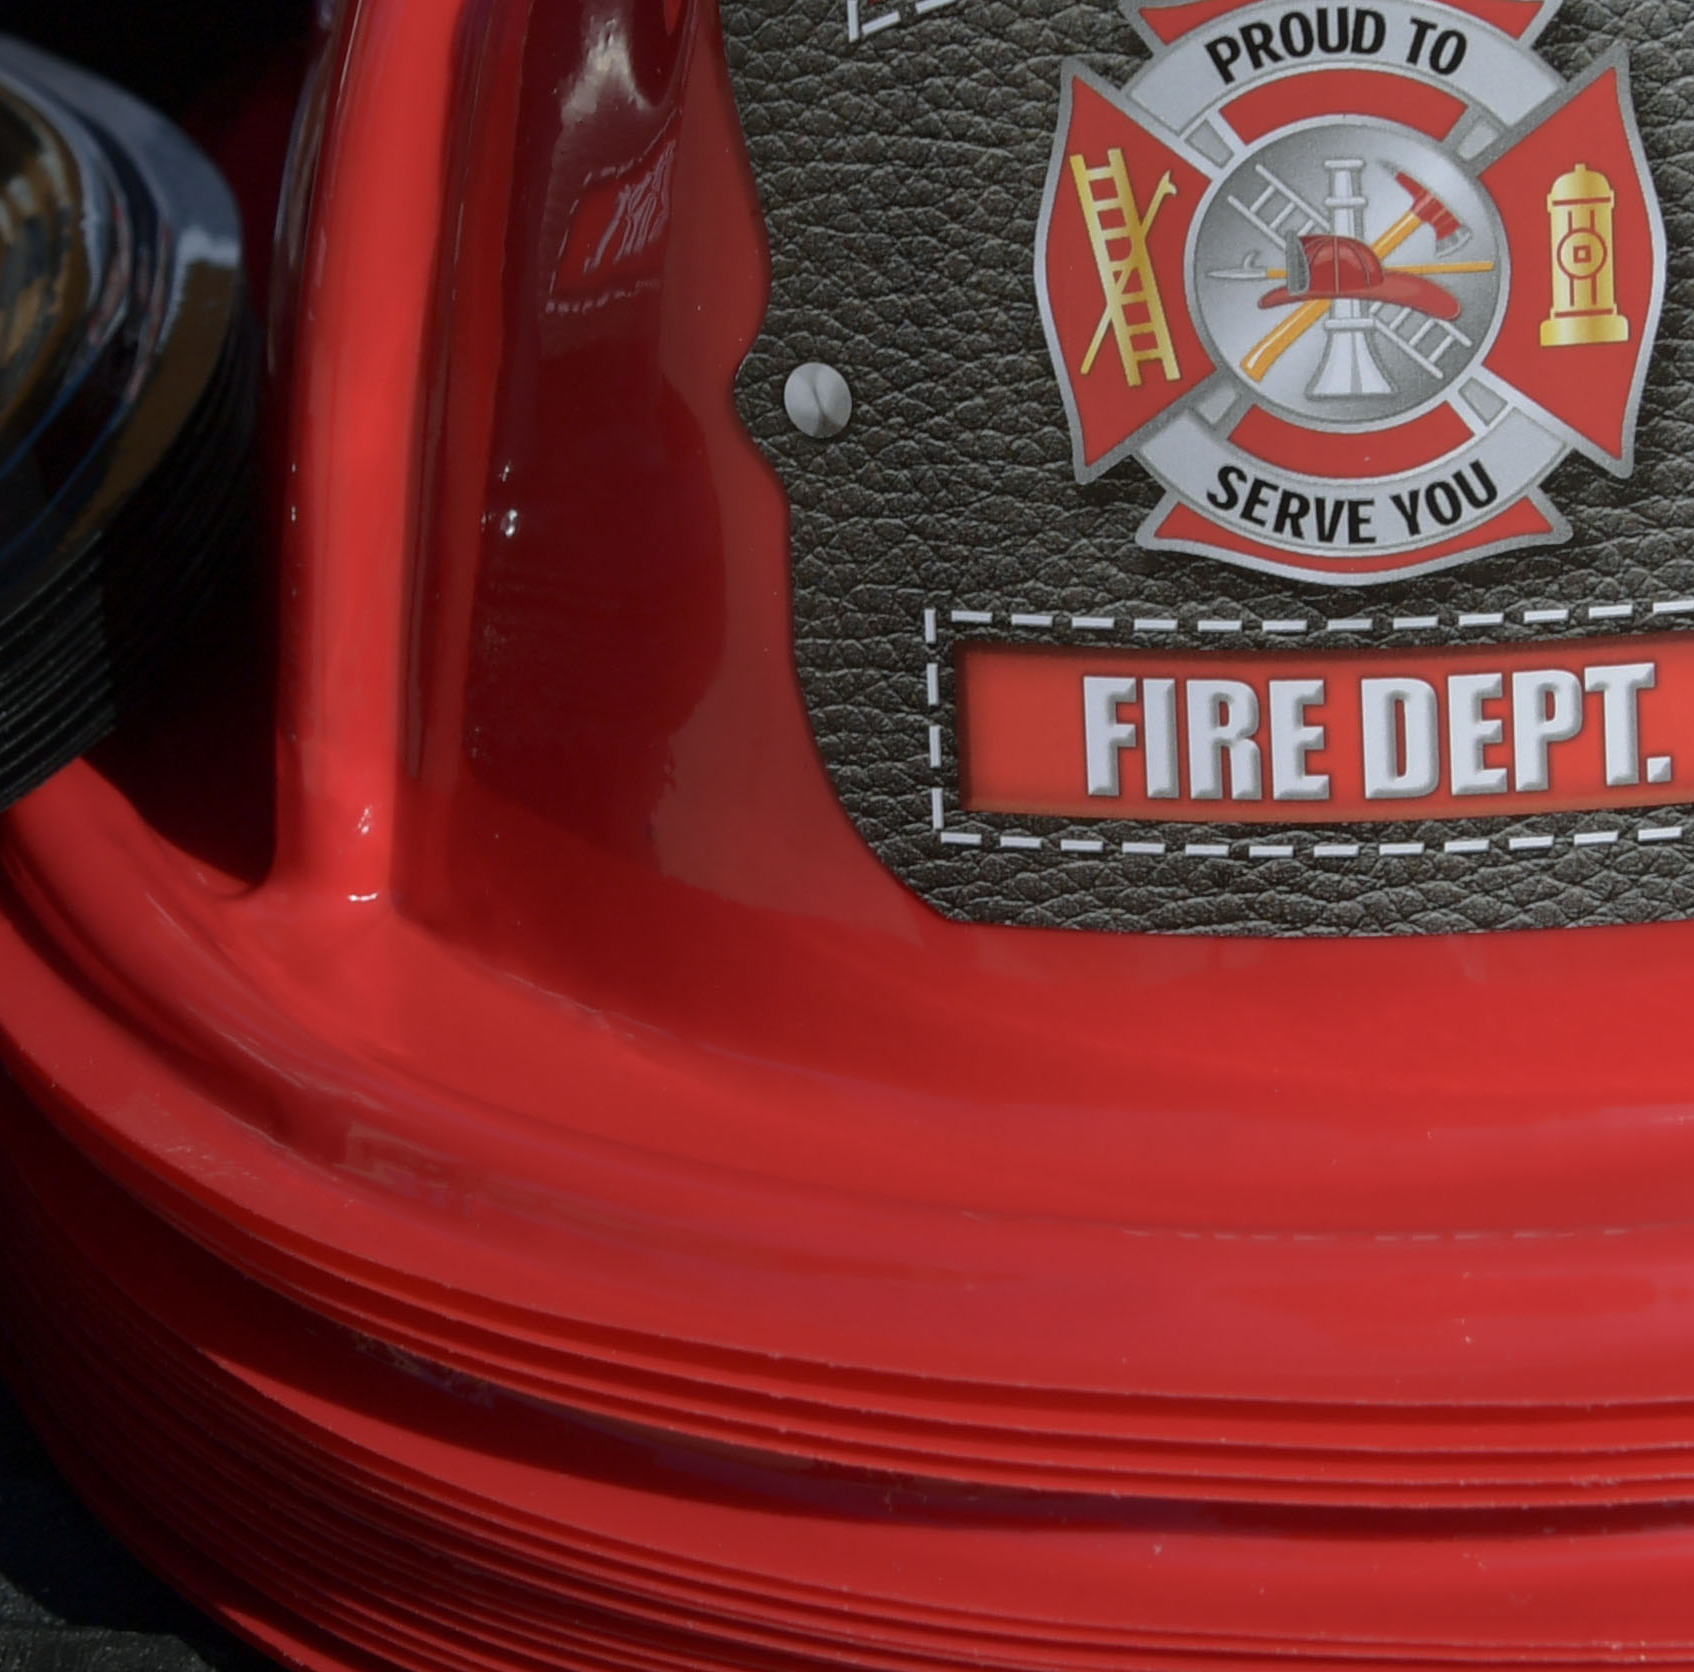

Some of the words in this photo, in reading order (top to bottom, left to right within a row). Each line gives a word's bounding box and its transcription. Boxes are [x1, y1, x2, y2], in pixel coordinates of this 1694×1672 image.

[1206, 8, 1385, 85] PROUD
[1408, 20, 1468, 75] TO
[1207, 465, 1377, 544] SERVE
[1393, 460, 1499, 536] YOU
[1081, 673, 1330, 800] FIRE
[1363, 662, 1673, 799] DEPT.
